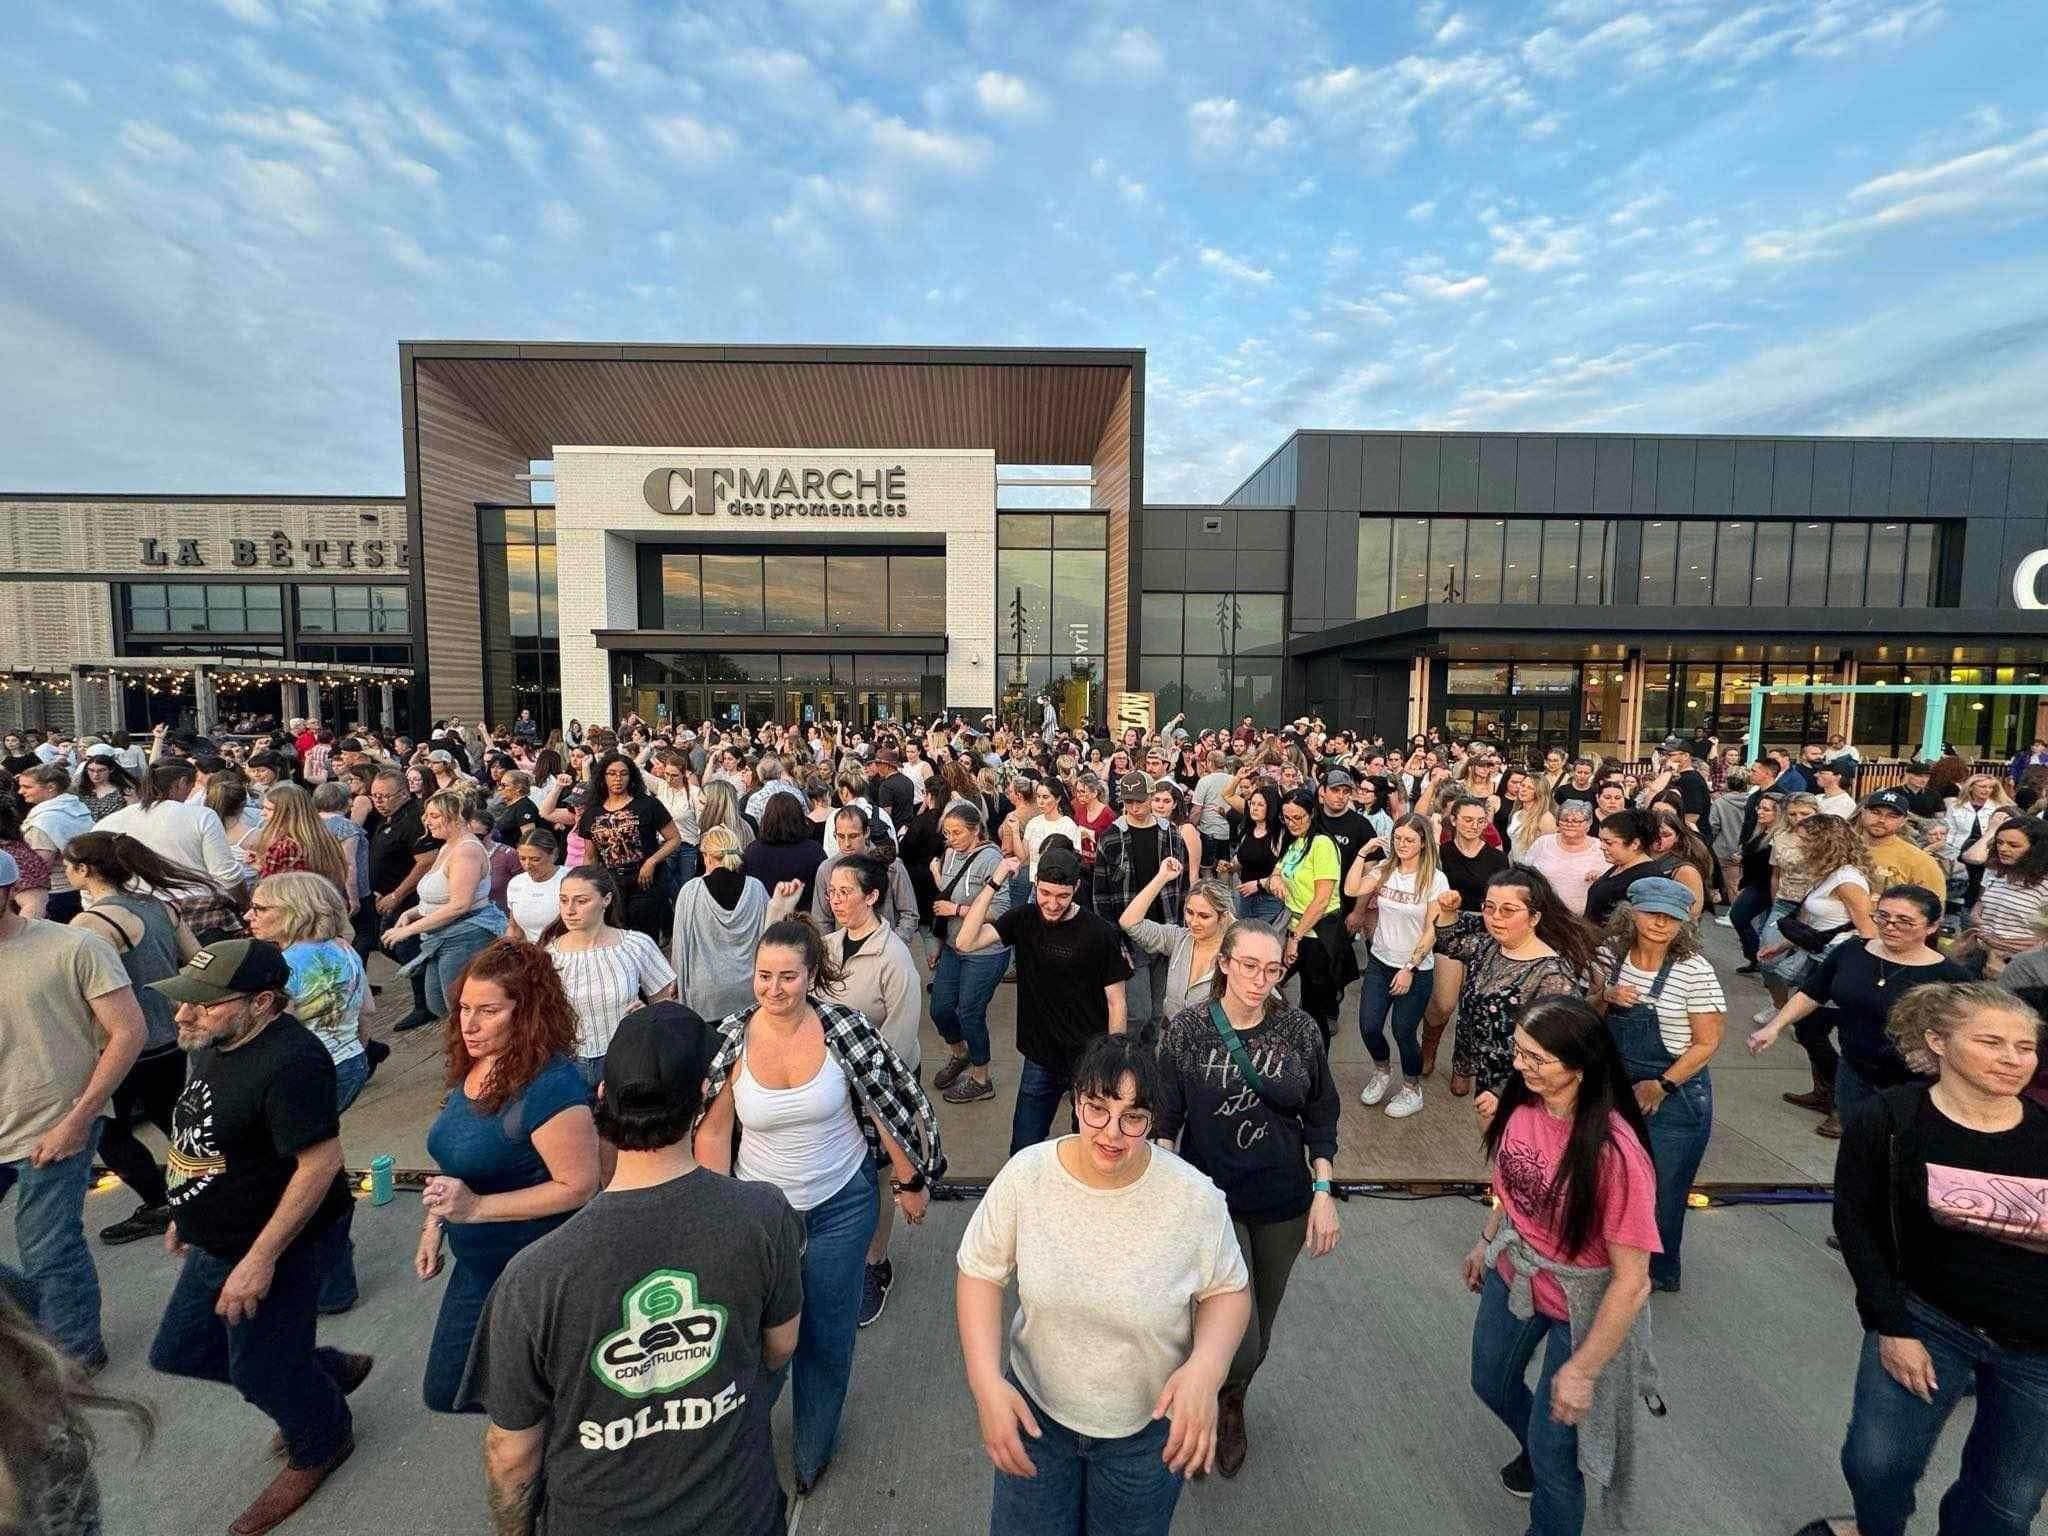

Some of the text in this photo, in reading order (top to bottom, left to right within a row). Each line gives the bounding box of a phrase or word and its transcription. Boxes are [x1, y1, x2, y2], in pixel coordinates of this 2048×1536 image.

[643, 465, 906, 516] CF MARCHÉ
[726, 500, 908, 519] des promenades
[140, 537, 204, 567] LA
[604, 1315, 717, 1365] CSD
[615, 1346, 711, 1380] CONSTRUCTION
[578, 1381, 746, 1451] SOLIDE.
